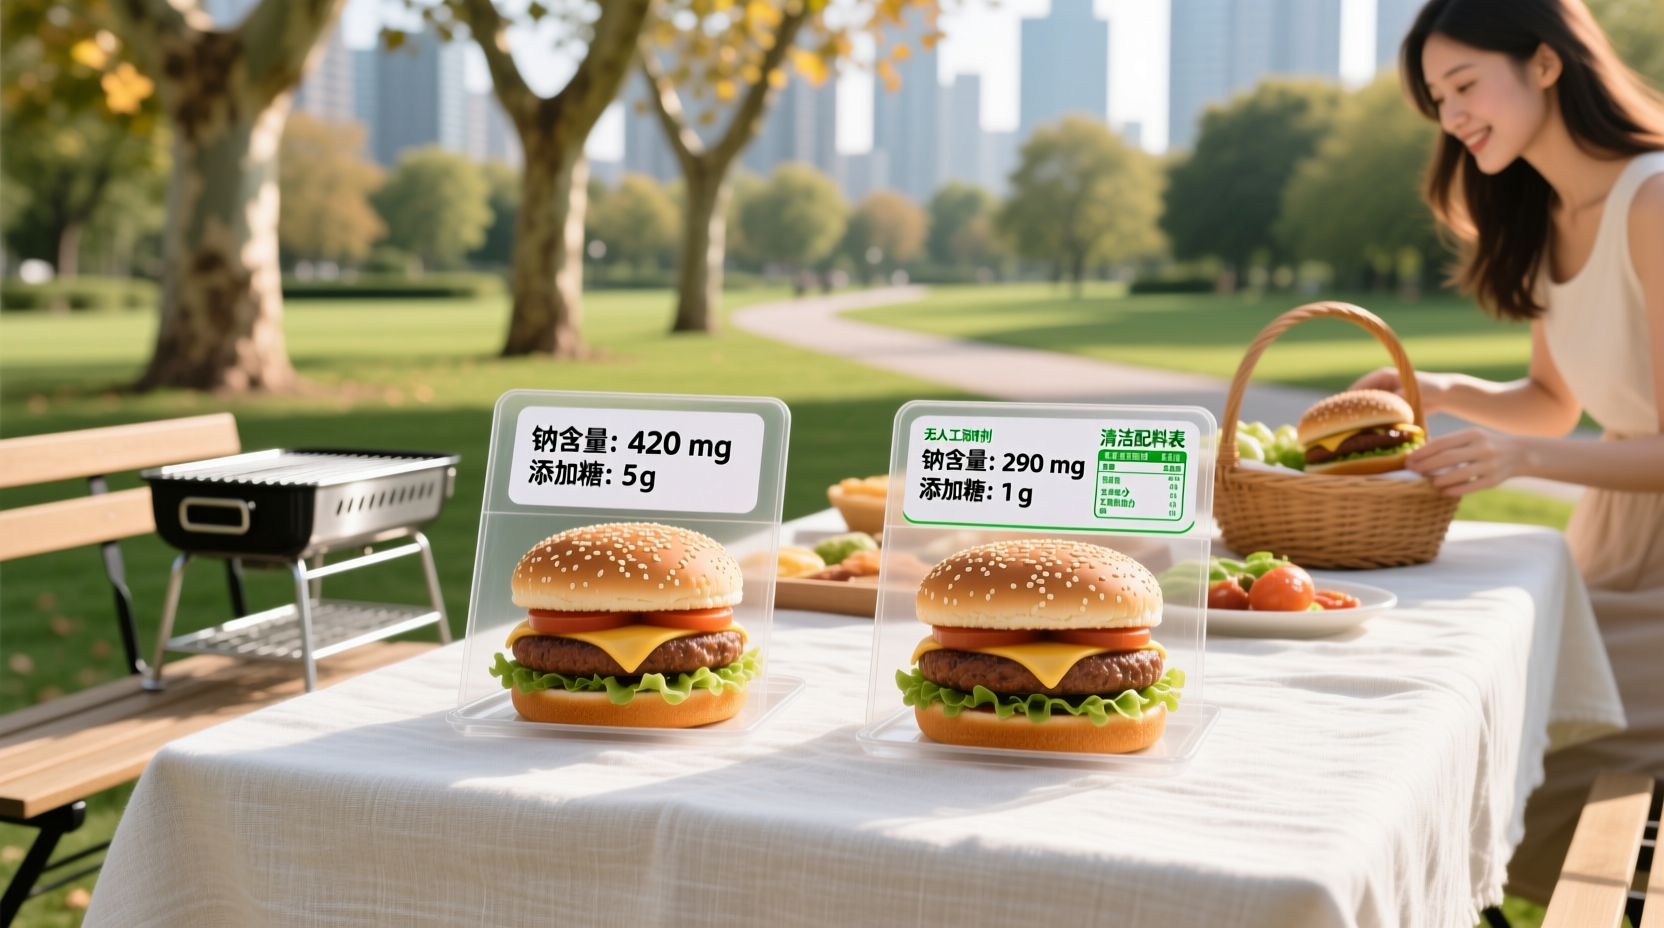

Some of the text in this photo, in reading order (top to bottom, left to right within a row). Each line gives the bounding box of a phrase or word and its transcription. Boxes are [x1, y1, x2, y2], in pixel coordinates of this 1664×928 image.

[531, 424, 732, 466] 钠含量: 420 mg
[1100, 428, 1186, 448] 清洁配料表
[528, 458, 613, 488] 添加糖:
[921, 448, 995, 472] 钠含量:
[1001, 452, 1044, 474] 290
[1049, 459, 1086, 481] mg
[918, 476, 994, 503] 添加糖:
